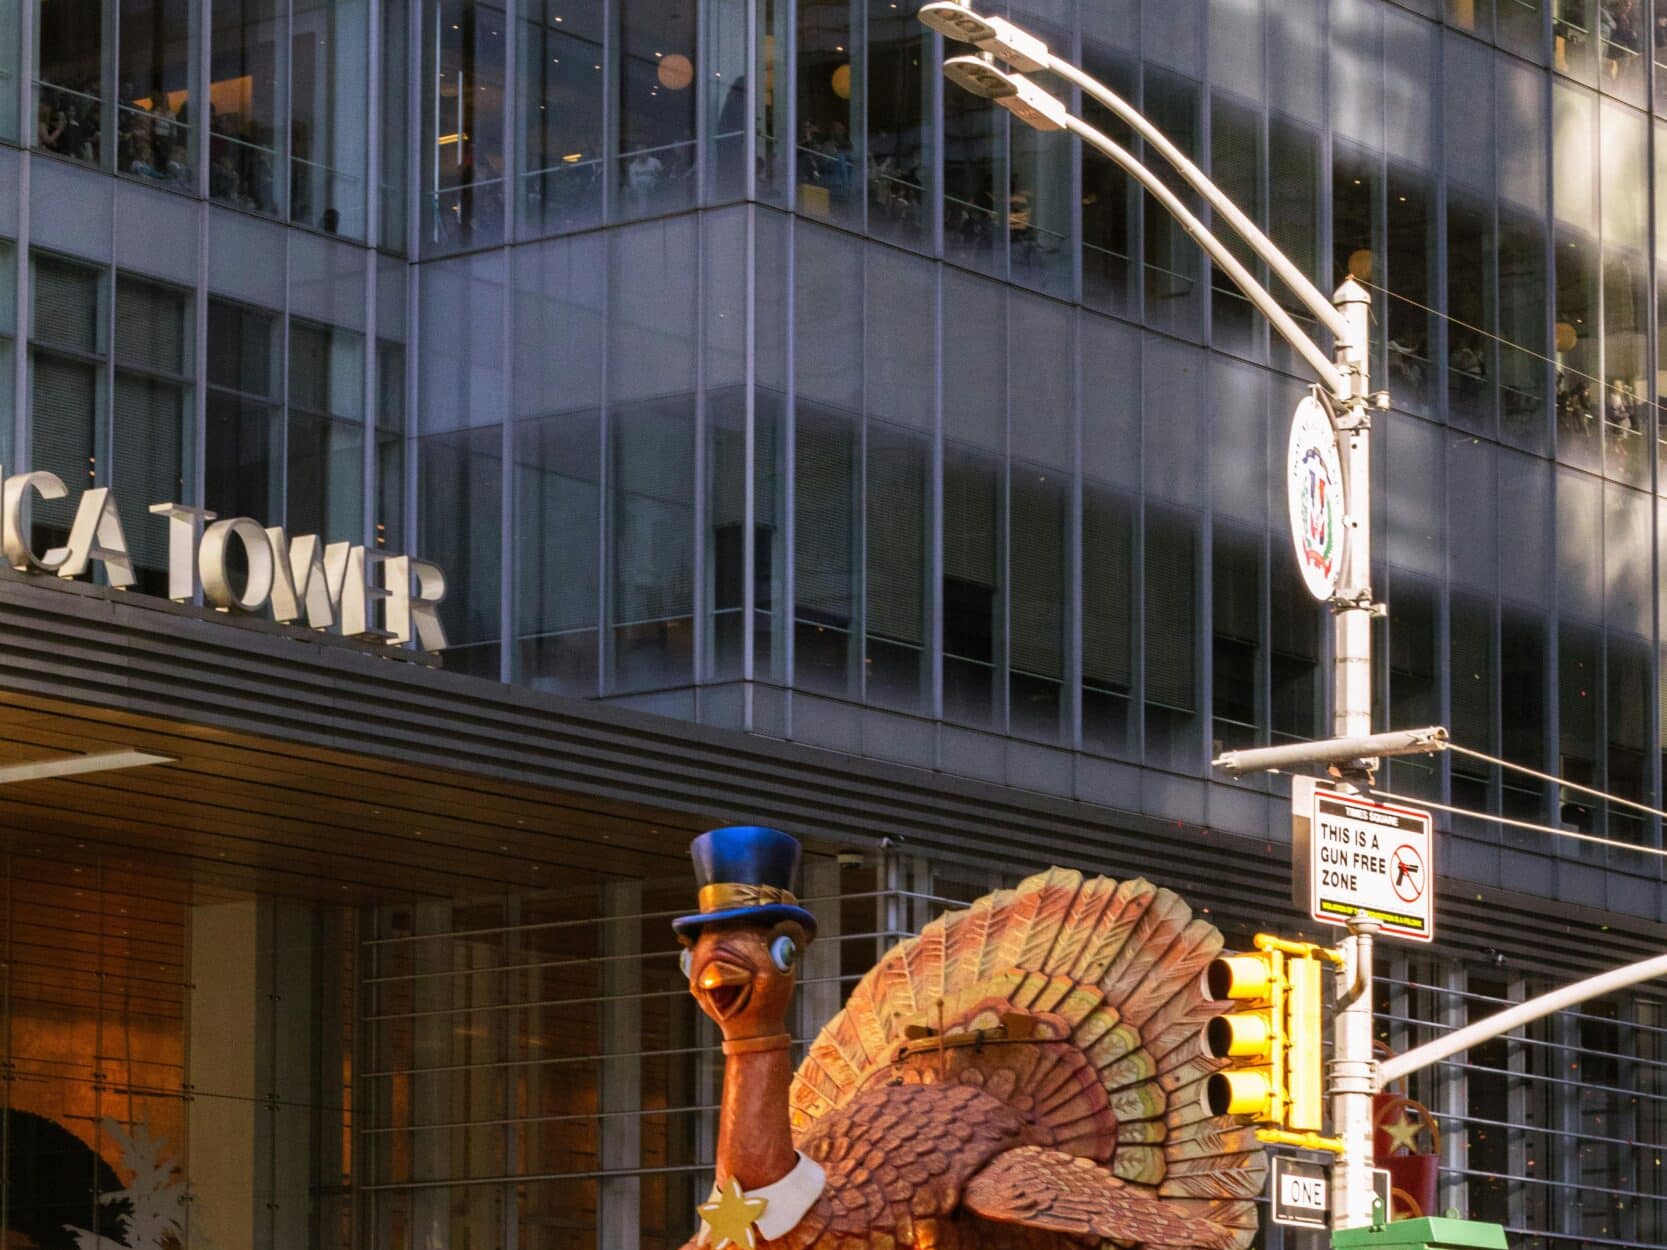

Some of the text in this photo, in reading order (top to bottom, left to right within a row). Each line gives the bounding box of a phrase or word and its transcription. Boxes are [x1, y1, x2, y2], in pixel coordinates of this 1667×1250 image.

[0, 464, 448, 651] CA TOWER
[1321, 823, 1380, 850] THIS IS A
[1321, 847, 1386, 874] GUN FREE
[1322, 869, 1358, 891] ZONE
[1291, 1180, 1322, 1206] ONE
